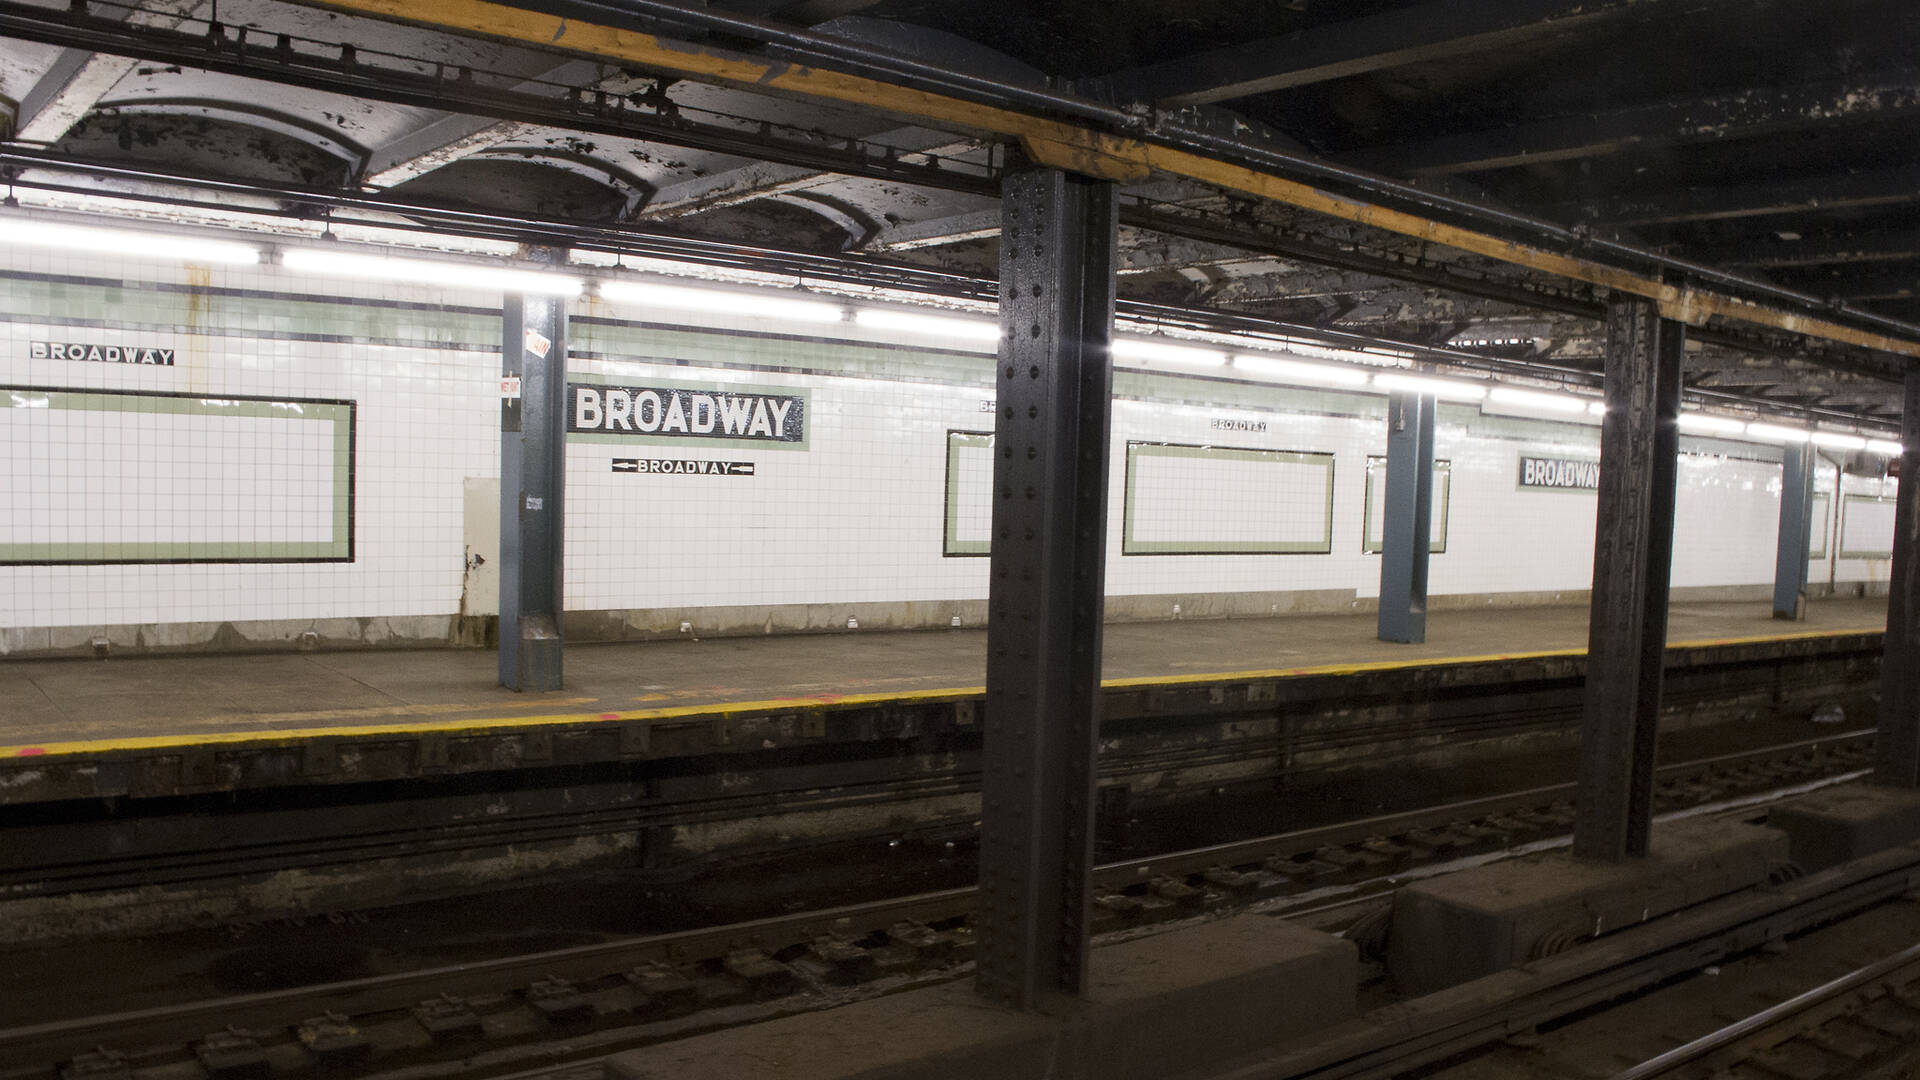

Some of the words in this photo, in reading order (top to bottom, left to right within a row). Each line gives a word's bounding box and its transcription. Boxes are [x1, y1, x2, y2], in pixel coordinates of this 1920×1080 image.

[31, 342, 173, 365] BROADWAY
[576, 388, 792, 437] BROADWAY
[637, 459, 732, 475] BROADWAY
[1524, 458, 1600, 488] BROADWAY
